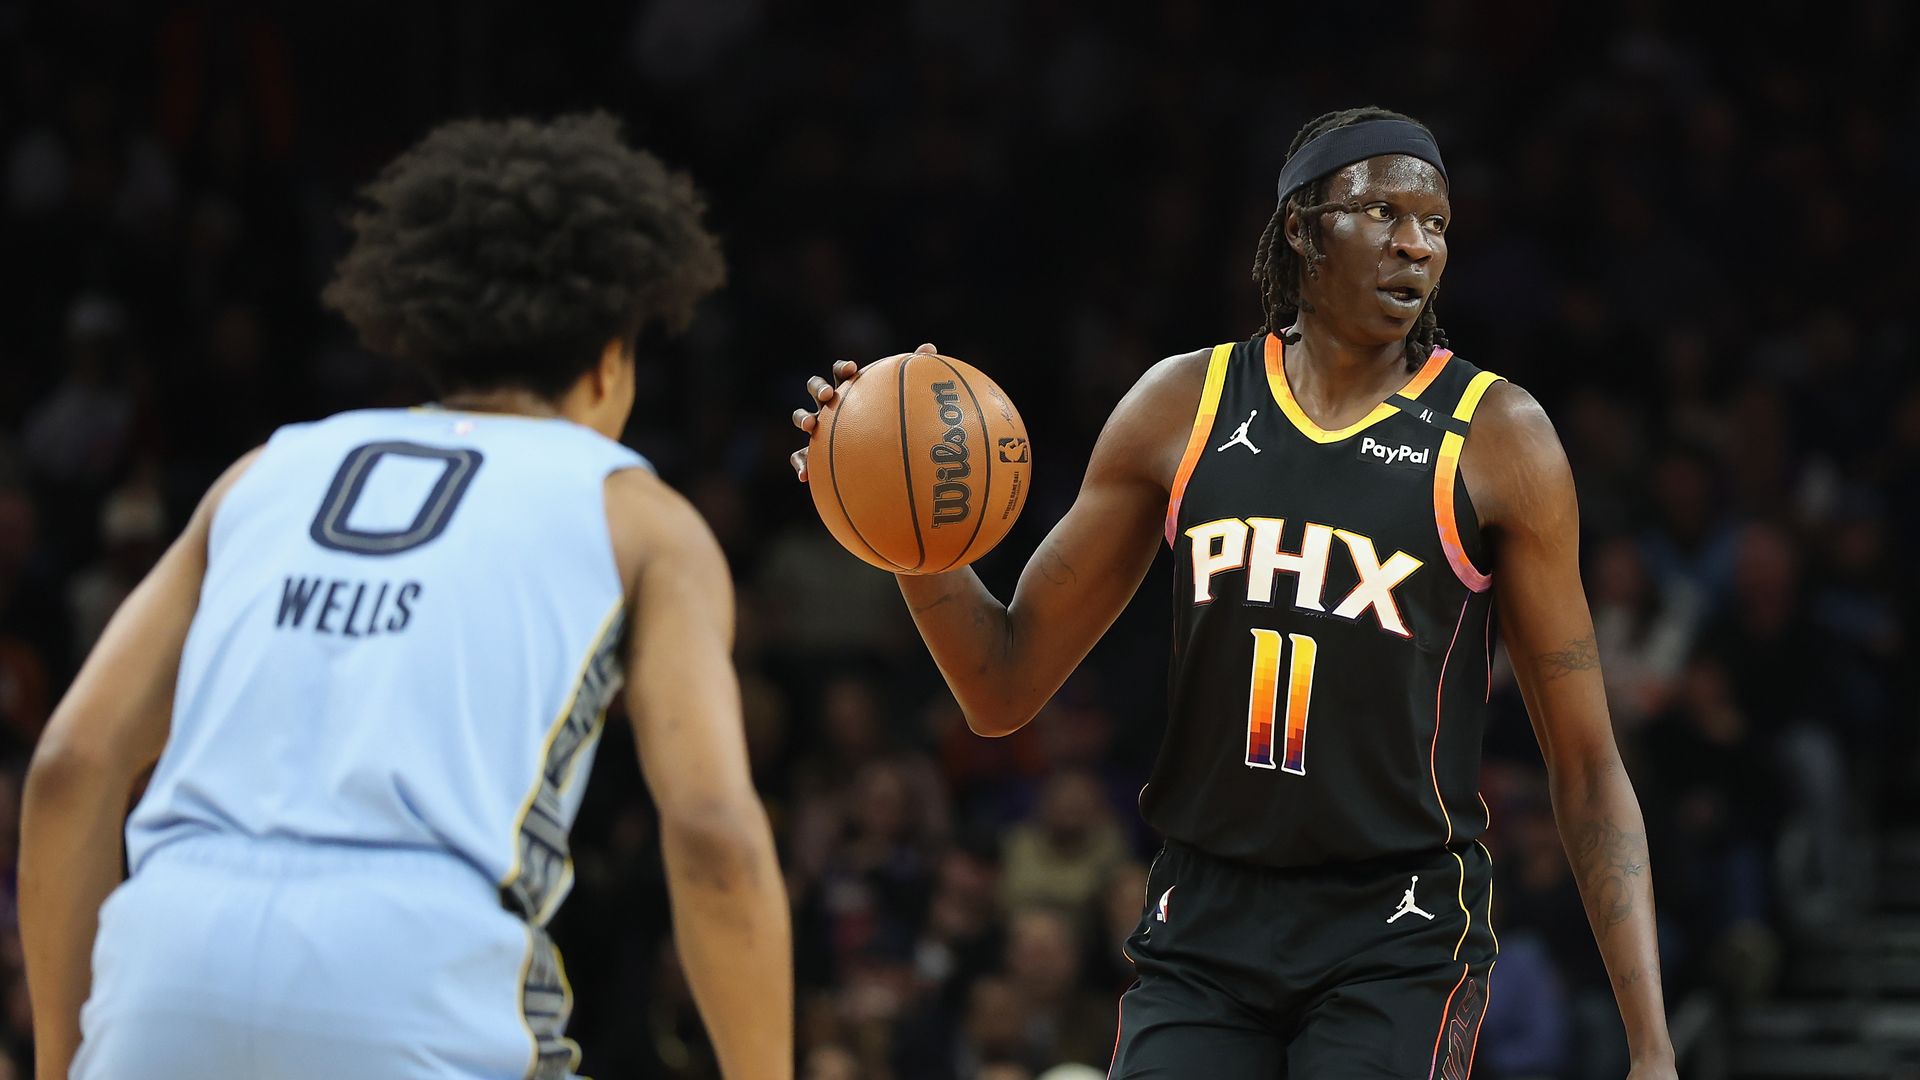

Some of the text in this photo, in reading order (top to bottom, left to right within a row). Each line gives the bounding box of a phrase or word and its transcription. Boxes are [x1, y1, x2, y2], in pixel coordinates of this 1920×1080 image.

[931, 380, 971, 528] Wilson
[1361, 437, 1429, 464] PayPal
[1419, 408, 1433, 424] AL
[309, 440, 484, 556] 0
[274, 575, 422, 639] WELLS
[1184, 515, 1425, 640] PHX
[1244, 627, 1318, 776] 11
